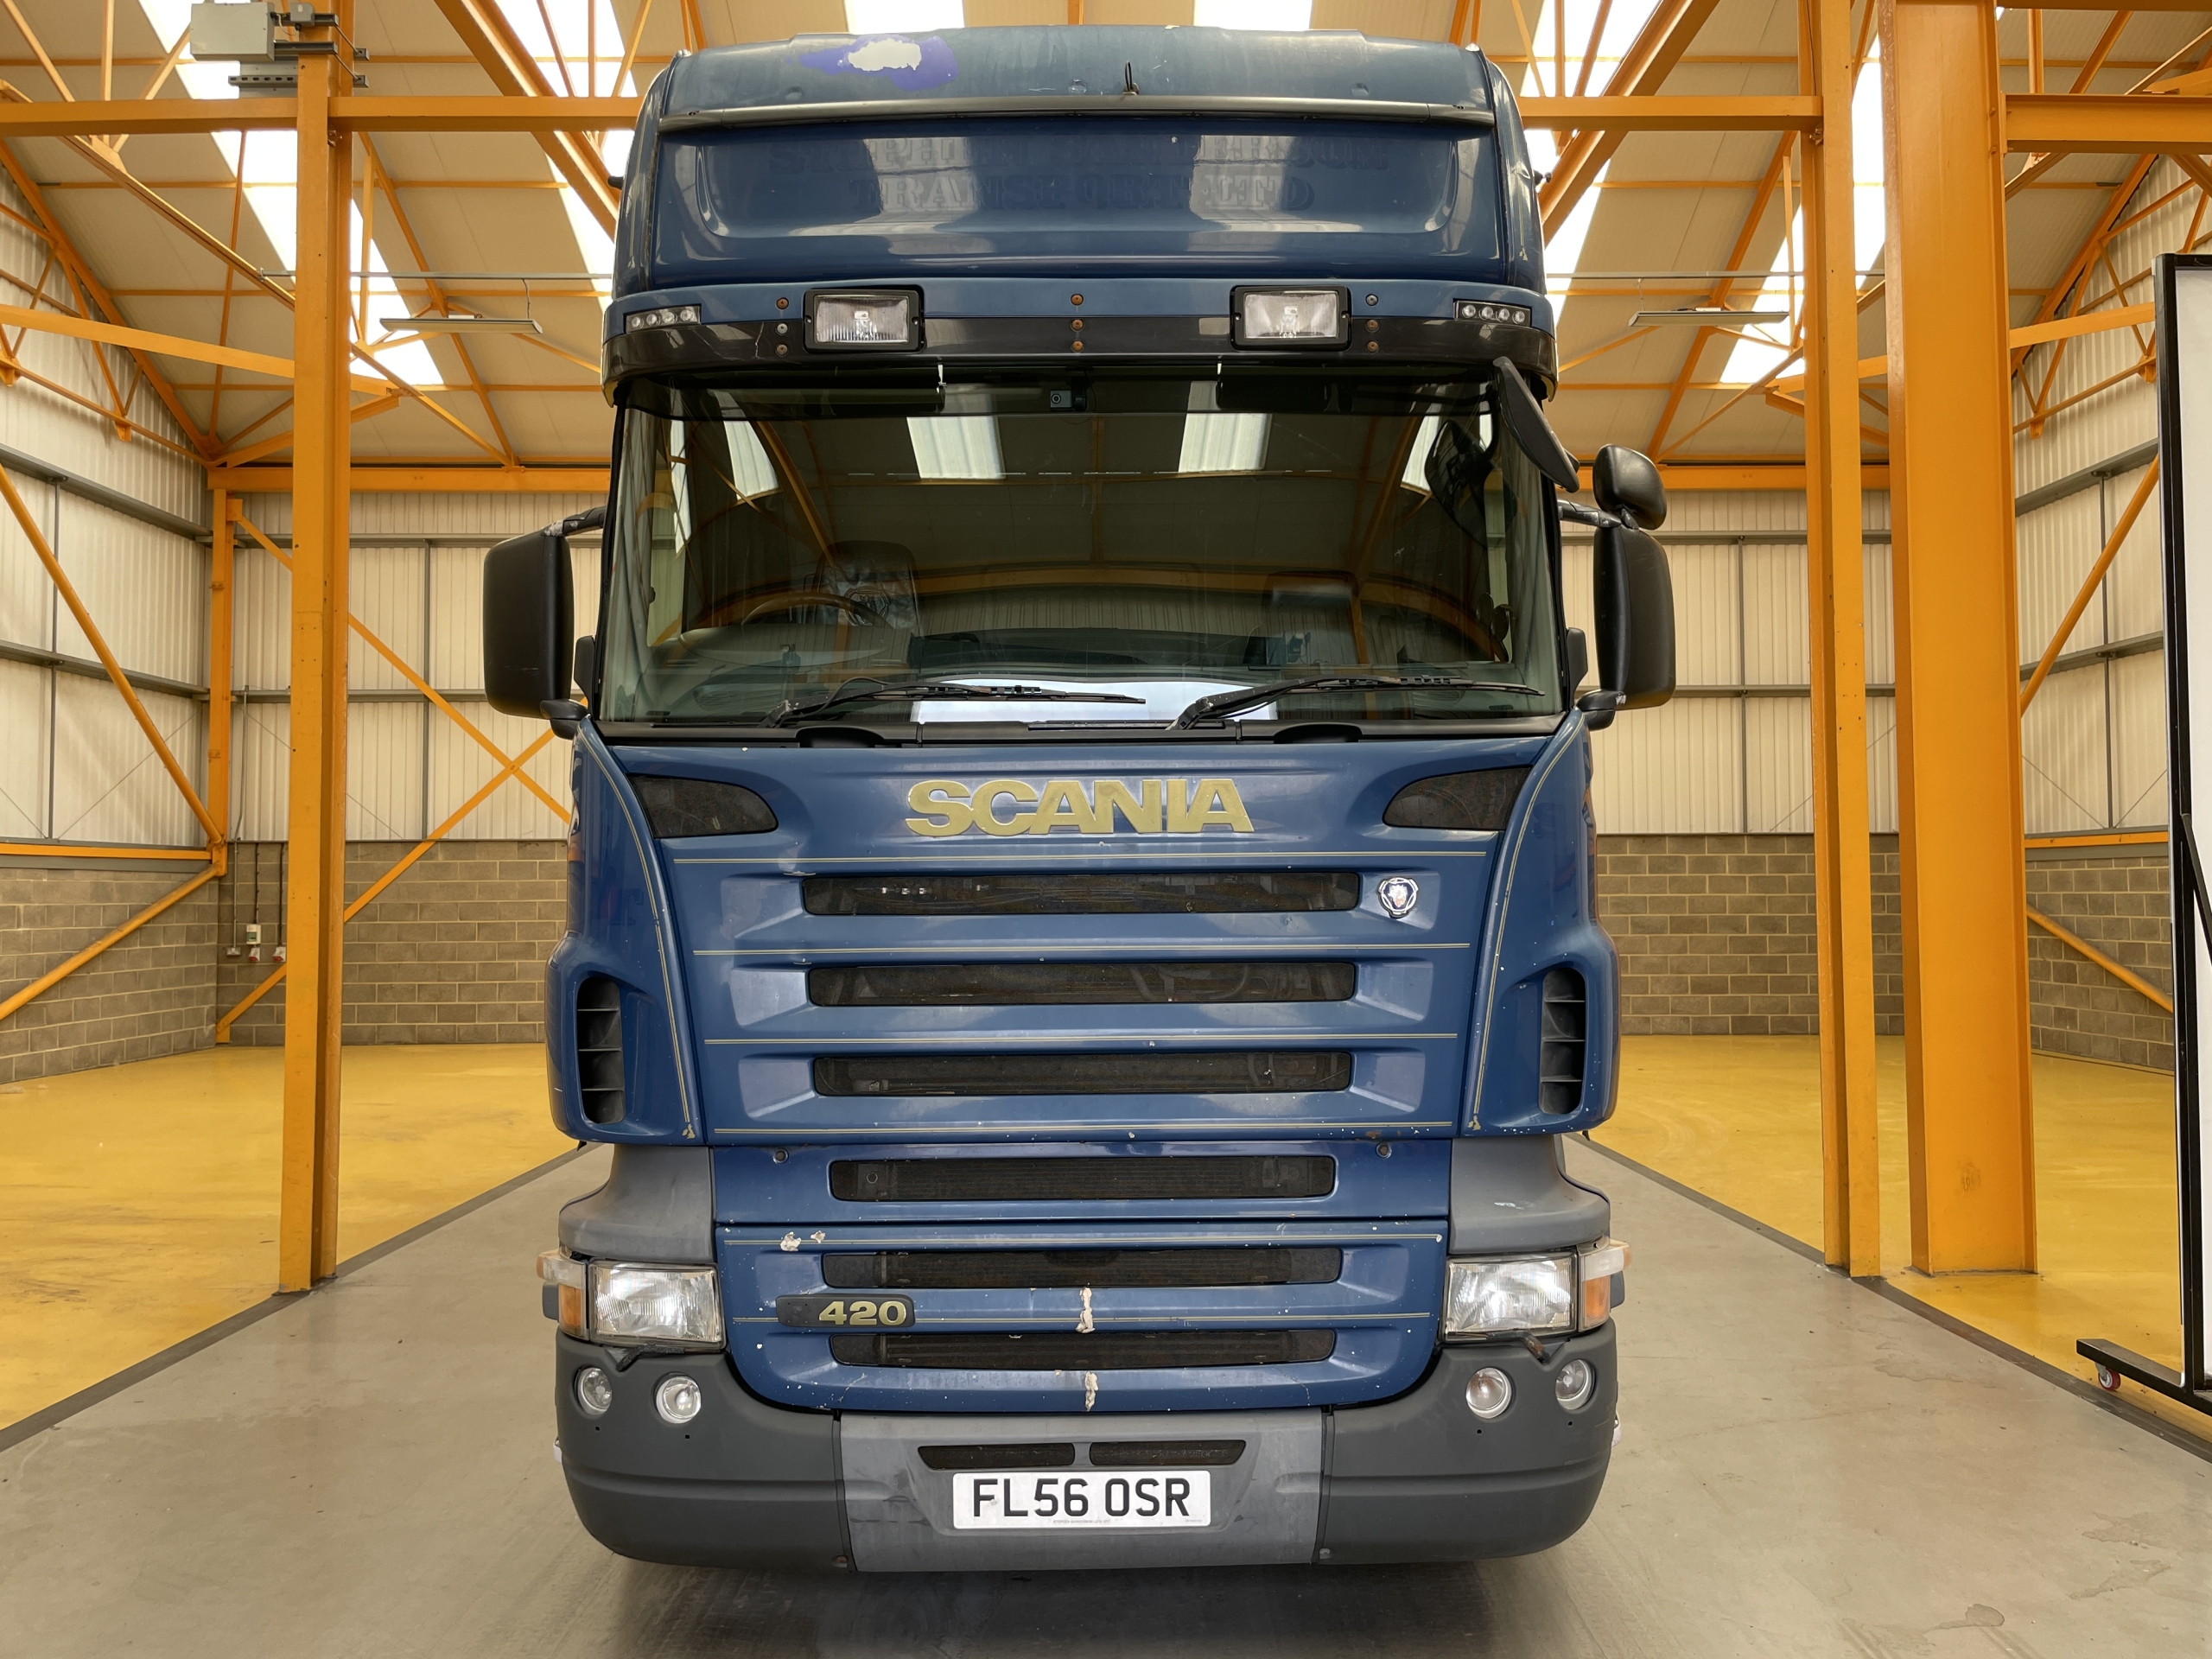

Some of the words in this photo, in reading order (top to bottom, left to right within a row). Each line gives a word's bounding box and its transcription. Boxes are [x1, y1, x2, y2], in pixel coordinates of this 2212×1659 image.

[849, 173, 1189, 213] TRANSPORT
[1205, 173, 1315, 211] LTD
[905, 779, 1255, 837] SCANIA
[818, 1300, 907, 1325] 420
[973, 1478, 1089, 1517] FL56
[1105, 1478, 1191, 1517] OSR
